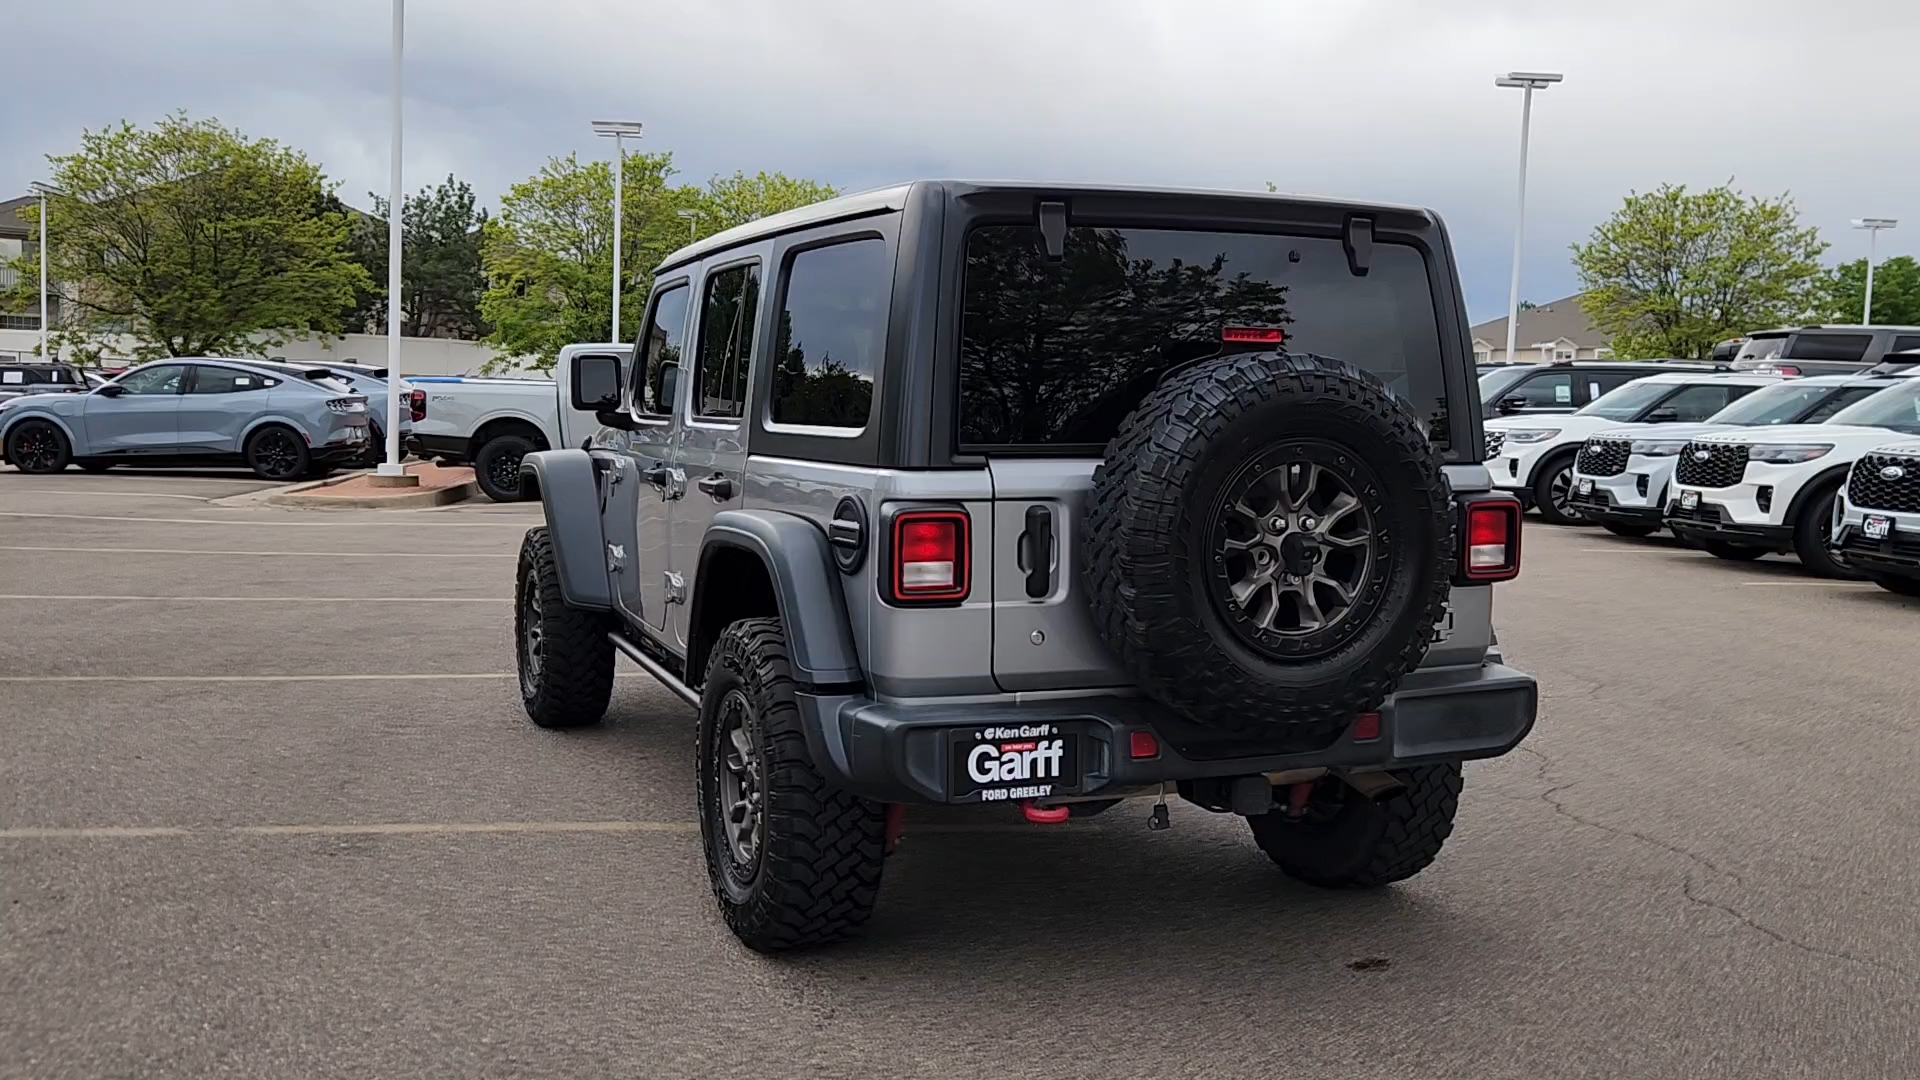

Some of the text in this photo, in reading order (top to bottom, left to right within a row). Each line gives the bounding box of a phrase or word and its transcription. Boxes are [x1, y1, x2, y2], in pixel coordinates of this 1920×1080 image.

[968, 740, 1063, 783] Garff
[982, 785, 1052, 801] FORD GREELEY
